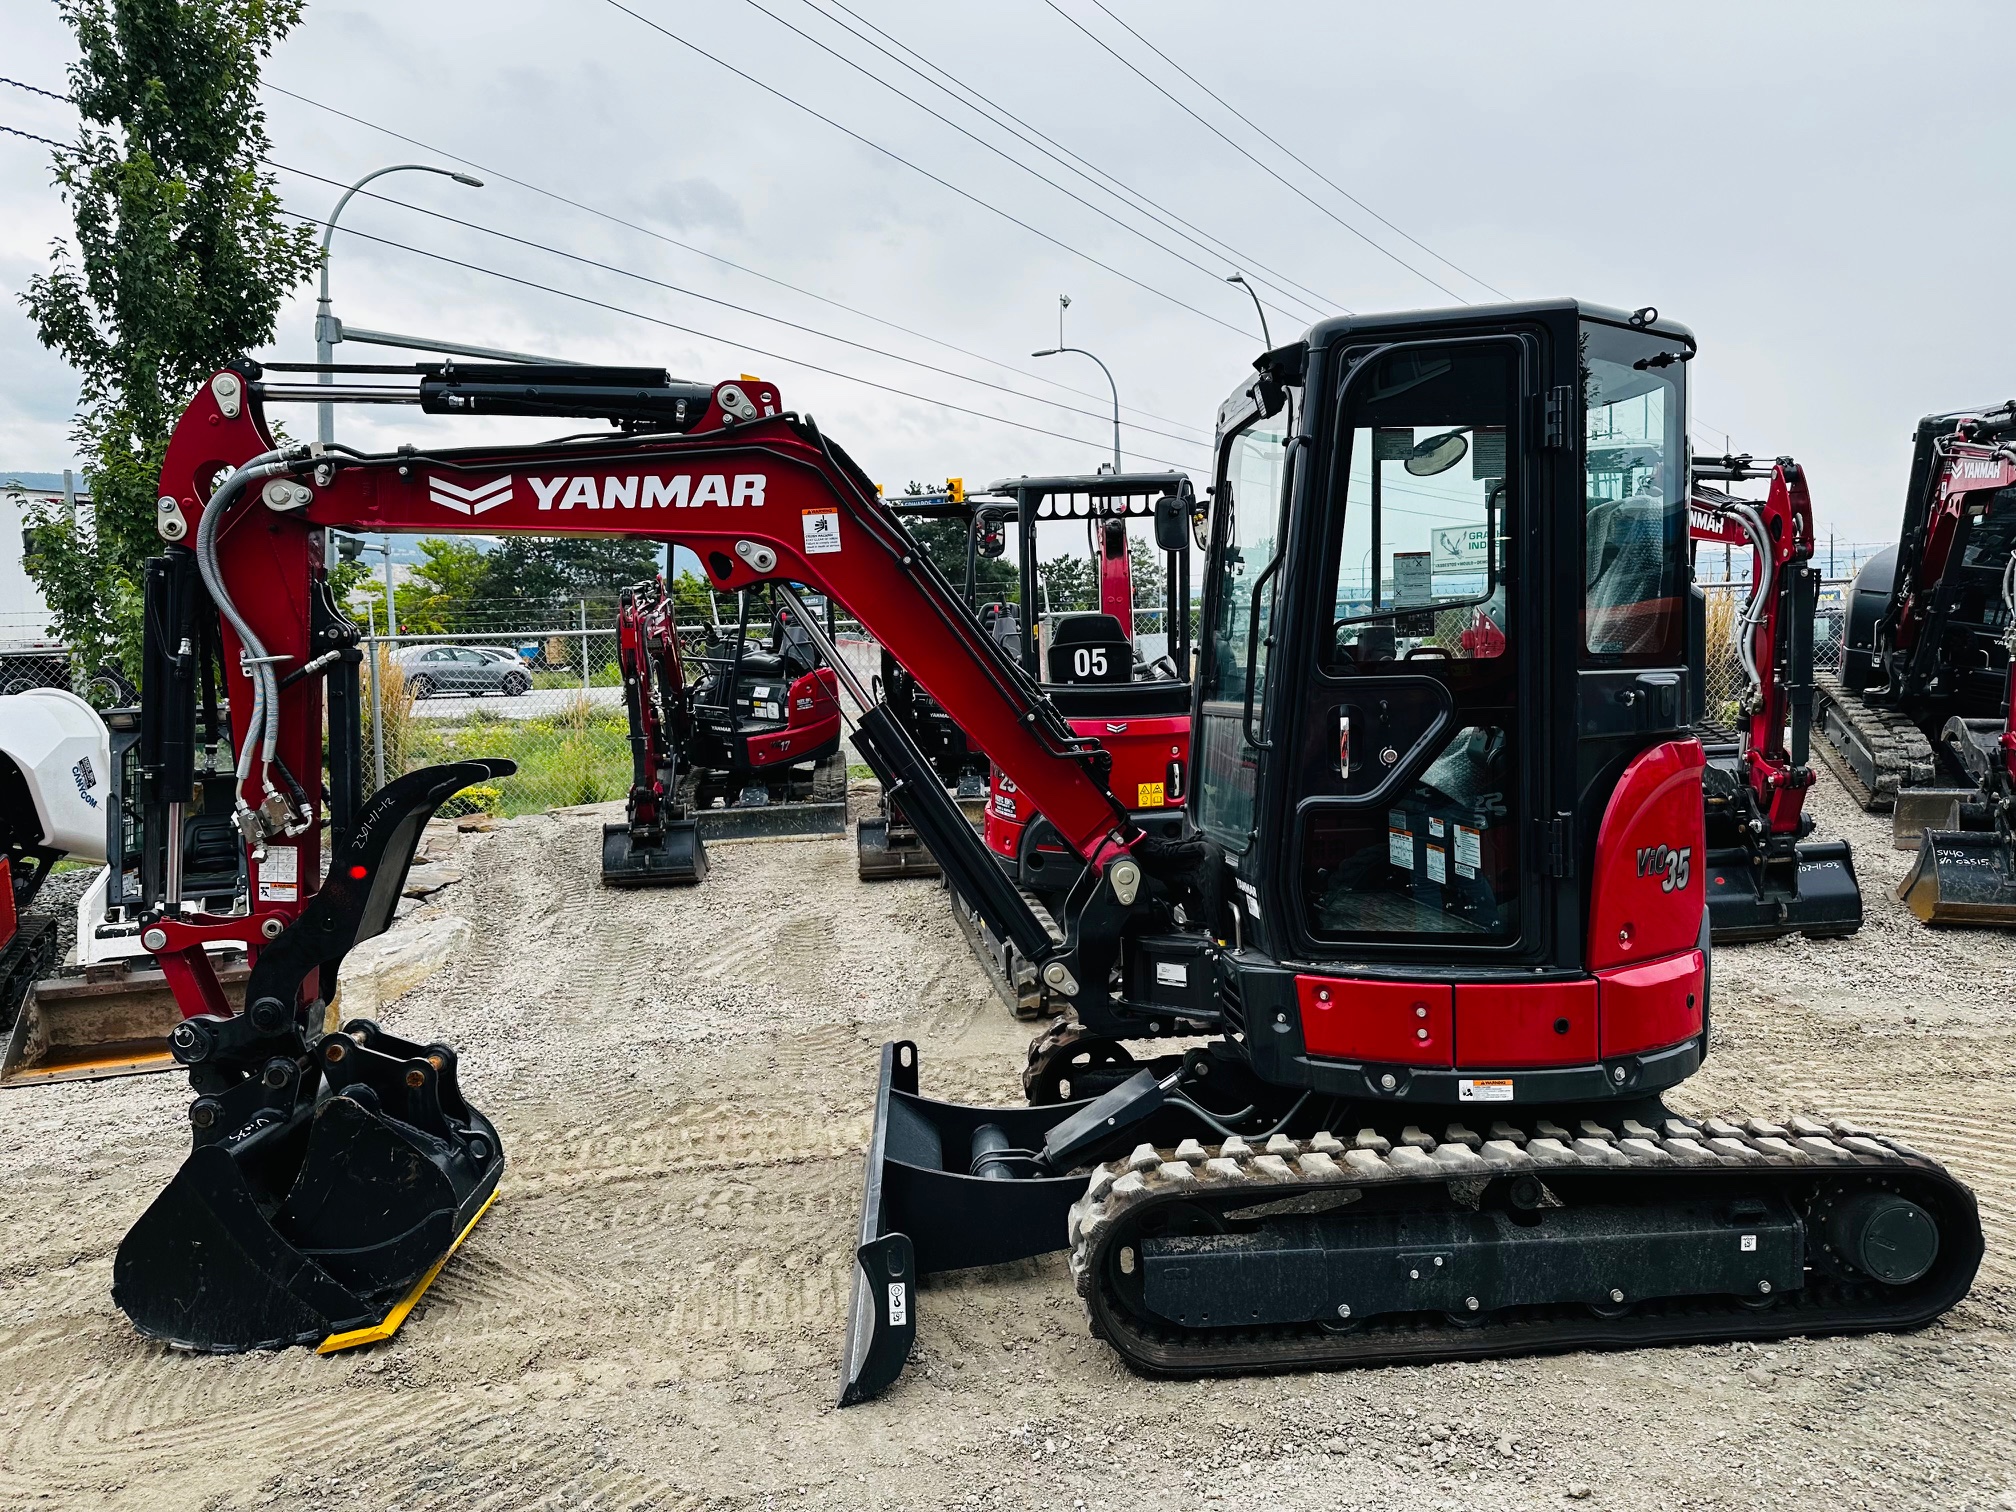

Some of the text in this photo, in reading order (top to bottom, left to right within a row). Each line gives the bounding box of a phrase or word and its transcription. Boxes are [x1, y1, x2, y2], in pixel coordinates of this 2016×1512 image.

[1964, 461, 2000, 478] YANMAR
[527, 474, 767, 510] YANMAR
[1074, 648, 1108, 677] 05
[72, 766, 98, 808] CANYCOM
